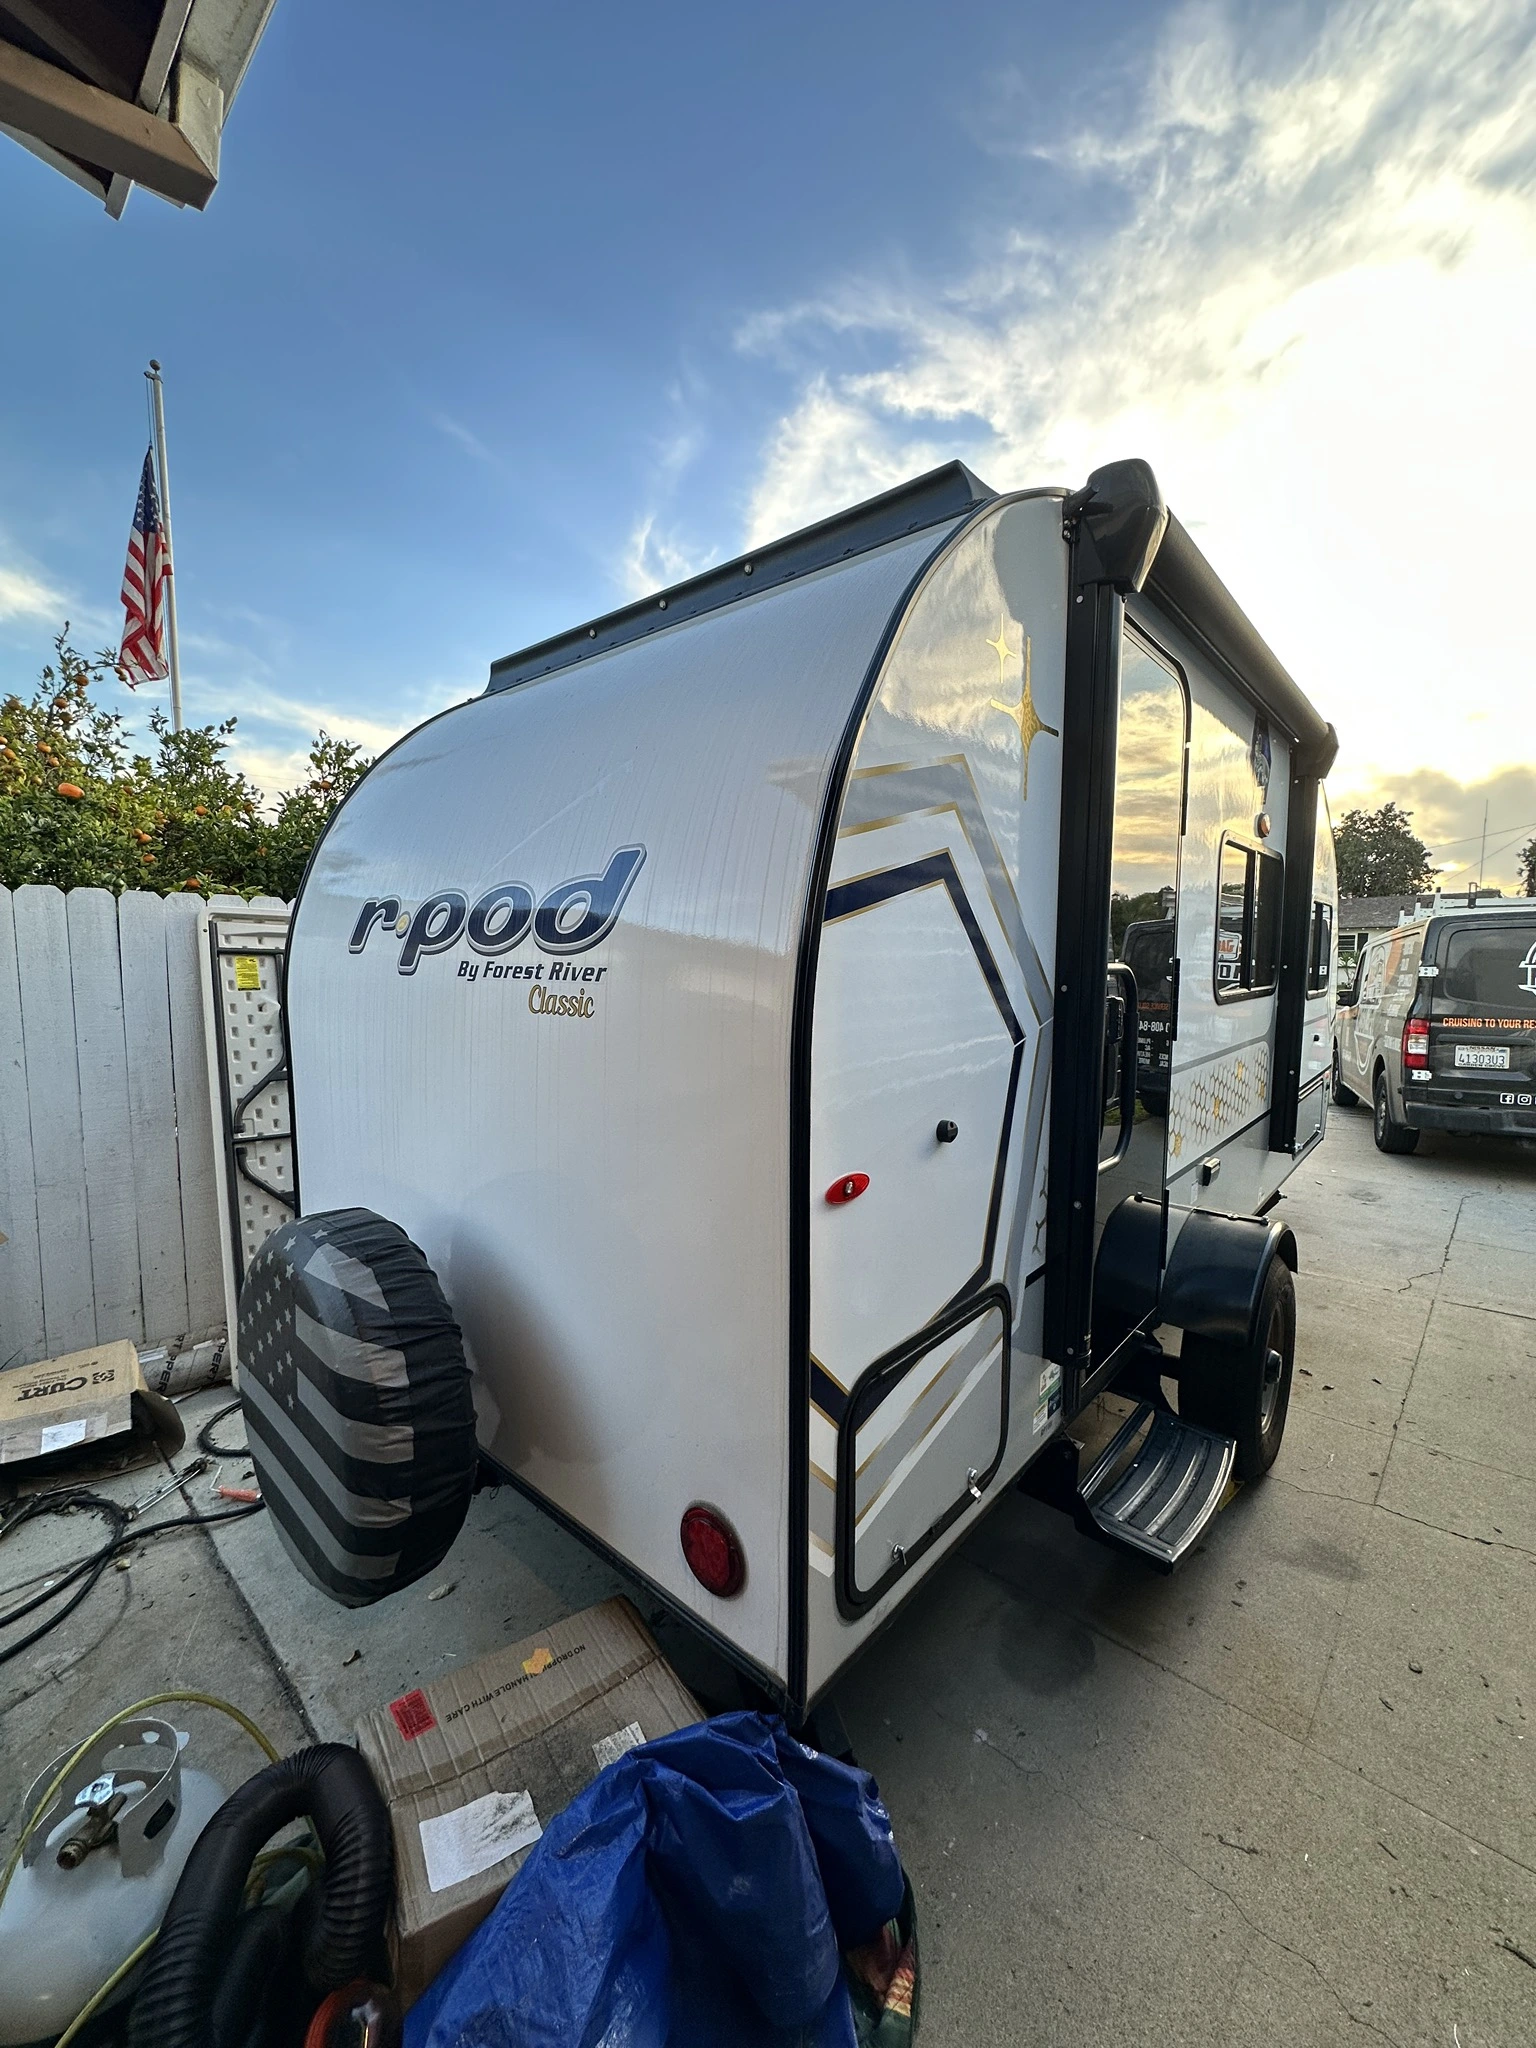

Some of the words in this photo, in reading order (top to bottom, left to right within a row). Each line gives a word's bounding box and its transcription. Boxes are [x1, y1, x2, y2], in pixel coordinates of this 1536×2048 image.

[457, 961, 479, 982] By
[483, 961, 545, 981] Forest
[549, 961, 608, 983] River
[528, 984, 596, 1019] Classic
[1442, 1017, 1483, 1028] CRUISING
[1485, 1018, 1496, 1029] TO
[1498, 1019, 1521, 1029] YOUR
[1458, 1053, 1506, 1066] 41303U3
[16, 1376, 88, 1402] CURT
[573, 1643, 586, 1656] NO
[493, 1674, 529, 1697] HANDLE
[471, 1692, 493, 1708] WITH
[445, 1704, 470, 1723] CARE
